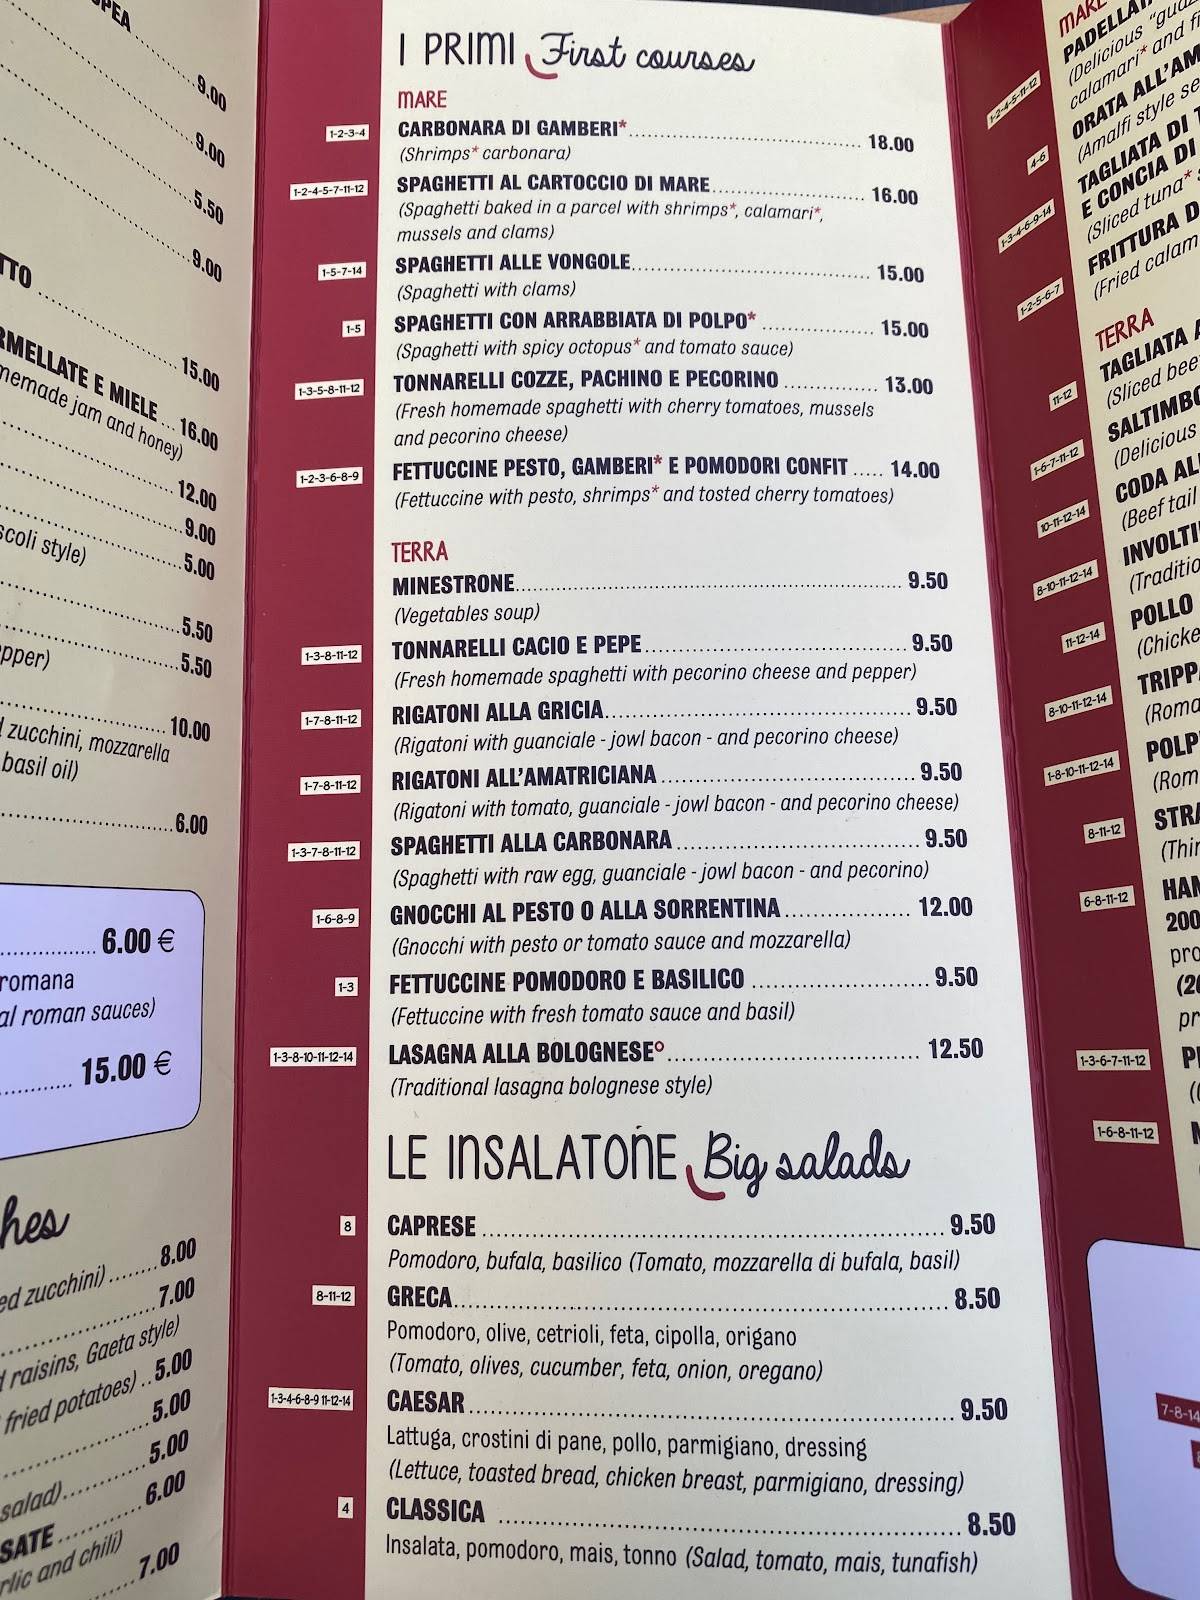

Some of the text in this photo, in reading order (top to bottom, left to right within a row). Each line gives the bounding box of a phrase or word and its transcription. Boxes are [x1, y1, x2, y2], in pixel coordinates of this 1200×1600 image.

[400, 32, 756, 72] I PRIMI First courses
[197, 74, 227, 112] 9.00
[398, 90, 447, 109] MARE
[1072, 92, 1128, 140] ORATA
[1136, 92, 1176, 126] style
[330, 128, 366, 139] 1-2-3-4
[398, 119, 506, 138] CARBONARA
[512, 119, 530, 136] DI
[868, 134, 914, 153] 18.00
[482, 145, 571, 161] carbonara)
[1030, 152, 1047, 169] 4-6
[1077, 132, 1162, 194] TAGLIATA
[293, 183, 365, 196] 1-2-4-5-7-11-12
[396, 174, 918, 206] SPAGHETTI AL CARTOCCIO DI MARE 16.00
[1097, 156, 1168, 208] CONCIA
[194, 188, 224, 226] 5.50
[1087, 198, 1140, 244] (Sliced
[1088, 212, 1180, 276] FRITTURA
[192, 248, 222, 283] 9.00
[395, 253, 924, 283] SPAGHETTI ALLE VONGOLE 15.00
[397, 280, 576, 303] (Spaghetti with clams)
[346, 323, 362, 334] 1-5
[394, 312, 493, 334] SPAGHETTI
[499, 311, 537, 330] CON
[543, 311, 658, 328] ARRABBIATA
[663, 311, 682, 328] DI
[881, 319, 929, 339] 15.00
[1094, 307, 1154, 352] TERRA
[1100, 326, 1188, 382] TAGLIATA
[182, 356, 220, 392] 15.00
[393, 369, 934, 395] TONNARELLI COZZE, PACHINO E PECORINO 13.00
[1052, 388, 1072, 406] 11-12
[93, 372, 218, 452] E MIELE 16.00
[393, 459, 498, 481] FETTUCCINE
[504, 457, 566, 480] PESTO,
[668, 456, 679, 474] E
[684, 456, 780, 475] POMODORI
[786, 456, 848, 476] CONFIT
[890, 460, 940, 479] 14.00
[1033, 446, 1079, 476] 1-6-7-11-12
[300, 470, 359, 484] 1-2-3-6-8-9
[1115, 466, 1168, 504] CODA
[178, 479, 217, 512] 12.00
[1122, 487, 1197, 531] (Beef tail
[391, 540, 449, 563] TERRA
[184, 552, 215, 581] 5.00
[1036, 566, 1093, 596] 8-10-11-12-14
[392, 570, 948, 596] MINESTRONE 9.50
[394, 602, 540, 627] (Vegetables soup)
[1130, 593, 1194, 630] POLLO
[182, 616, 213, 644] 5.50
[304, 648, 358, 661] 1-3-8-11-12
[391, 633, 953, 660] TONNARELLI CACIO E PEPE 9.50
[304, 714, 358, 726] 1-7-8-11-12
[392, 696, 958, 725] RIGATONI ALLA GRICIA 9.50
[170, 716, 211, 742] 10.00
[88, 736, 170, 763] mozzarella
[304, 779, 358, 791] 1-7-8-11-12
[392, 768, 480, 791] RIGATONI
[920, 762, 962, 782] 9.50
[175, 812, 208, 836] 6.00
[390, 828, 968, 856] SPAGHETTI ALLA CARBONARA 9.50
[390, 896, 973, 926] GNOCCHI AL PESTO O ALLA SORRENTINA 12.00
[1084, 892, 1128, 908] 6-8-11-12
[316, 912, 356, 925] 1-6-8-9
[102, 927, 176, 955] 6.00 €
[338, 981, 354, 992] 1-3
[390, 966, 978, 995] FETTUCCINE POMODORO E BASILICO 9.50
[21, 996, 156, 1026] roman sauces)
[272, 1050, 354, 1064] 1-3-8-10-11-12-14
[389, 1043, 478, 1065] LASAGNA
[482, 1042, 531, 1064] ALLA
[928, 1037, 984, 1059] 12.50
[1080, 1055, 1146, 1066] 1-3-6-7-11-12
[82, 1050, 172, 1086] 15.00 €
[390, 1074, 712, 1100] (Traditional lasagna bolognese style)
[388, 1134, 428, 1180] LE
[702, 1130, 768, 1198] Big
[775, 1128, 911, 1181] salads
[387, 1212, 996, 1238] CAPRESE 9.50
[160, 1237, 197, 1268] 8.00
[316, 1290, 352, 1302] 8-11-12
[387, 1284, 1001, 1310] GRECA 8.50
[154, 1348, 192, 1382] 5.00
[54, 1370, 137, 1422] potatoes)
[387, 1389, 1008, 1422] CAESAR 9.50
[145, 1469, 186, 1506] 6.00
[342, 1502, 350, 1514] 4
[386, 1496, 1016, 1536] CLASSICA 8.50
[139, 1542, 180, 1580] 7.00
